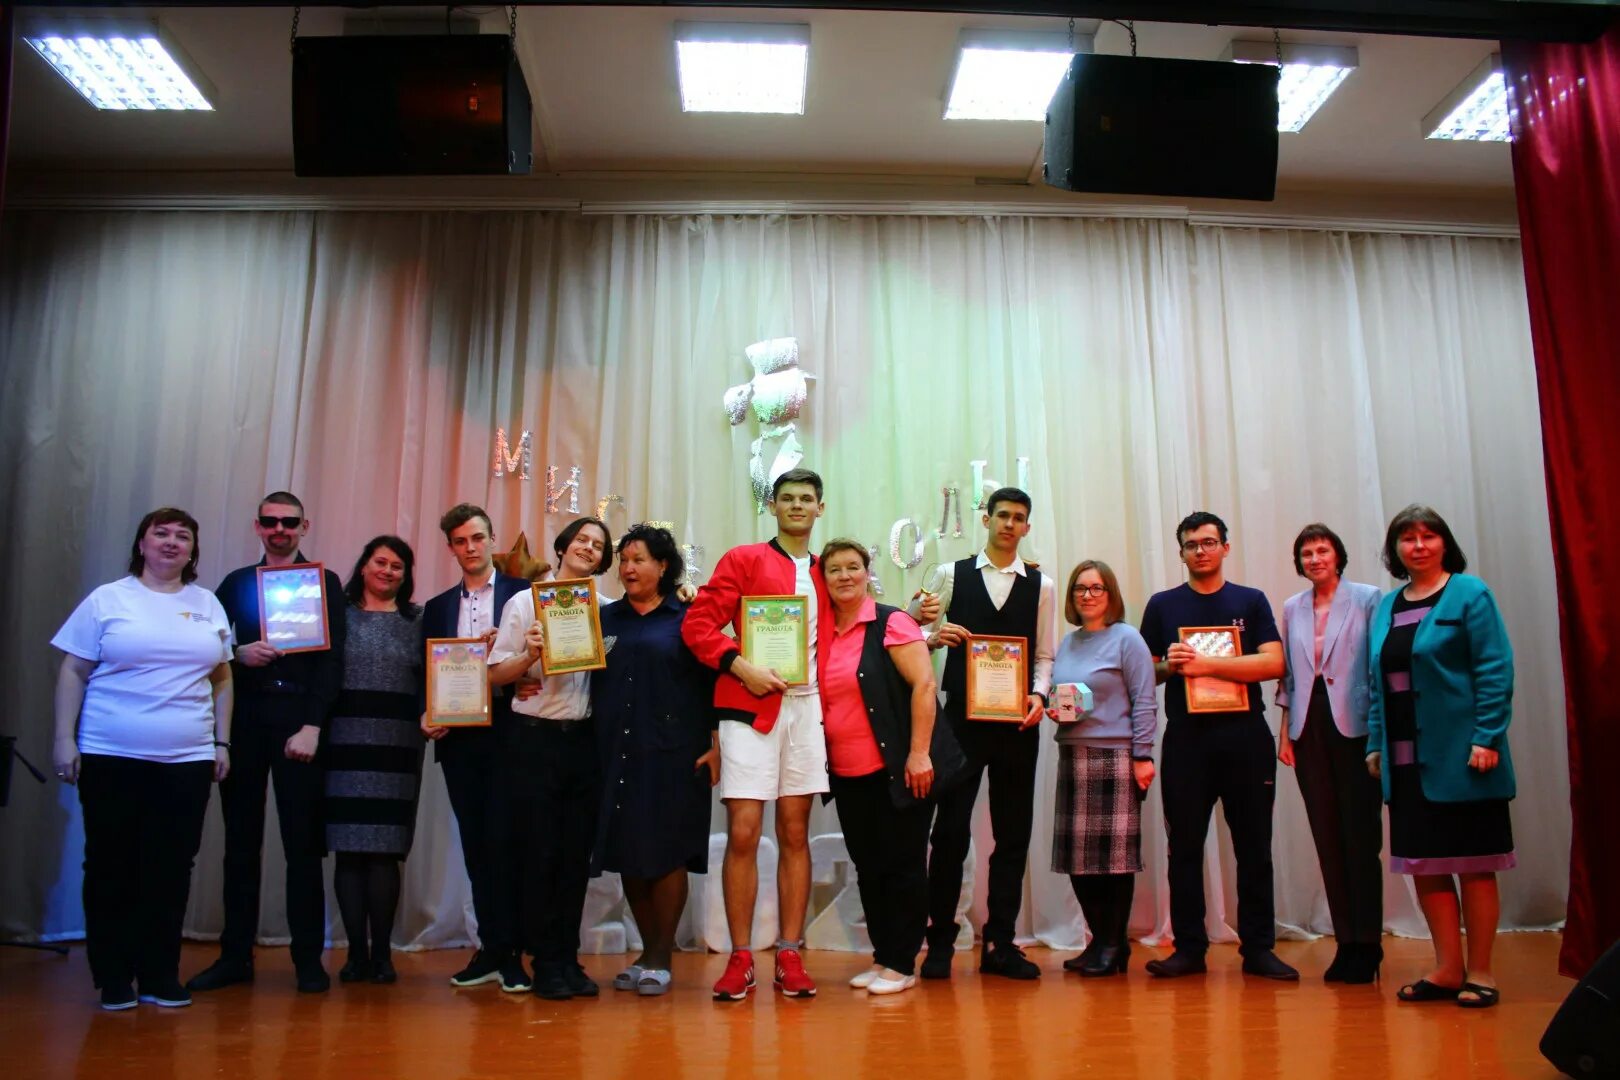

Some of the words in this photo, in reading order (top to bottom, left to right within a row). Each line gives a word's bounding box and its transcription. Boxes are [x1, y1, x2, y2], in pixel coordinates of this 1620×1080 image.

[868, 457, 1030, 596] ОЛЫ
[548, 608, 584, 618] ГРАМОТА
[440, 664, 479, 672] ГРАМОТА
[979, 661, 1013, 669] ГРАМОТА
